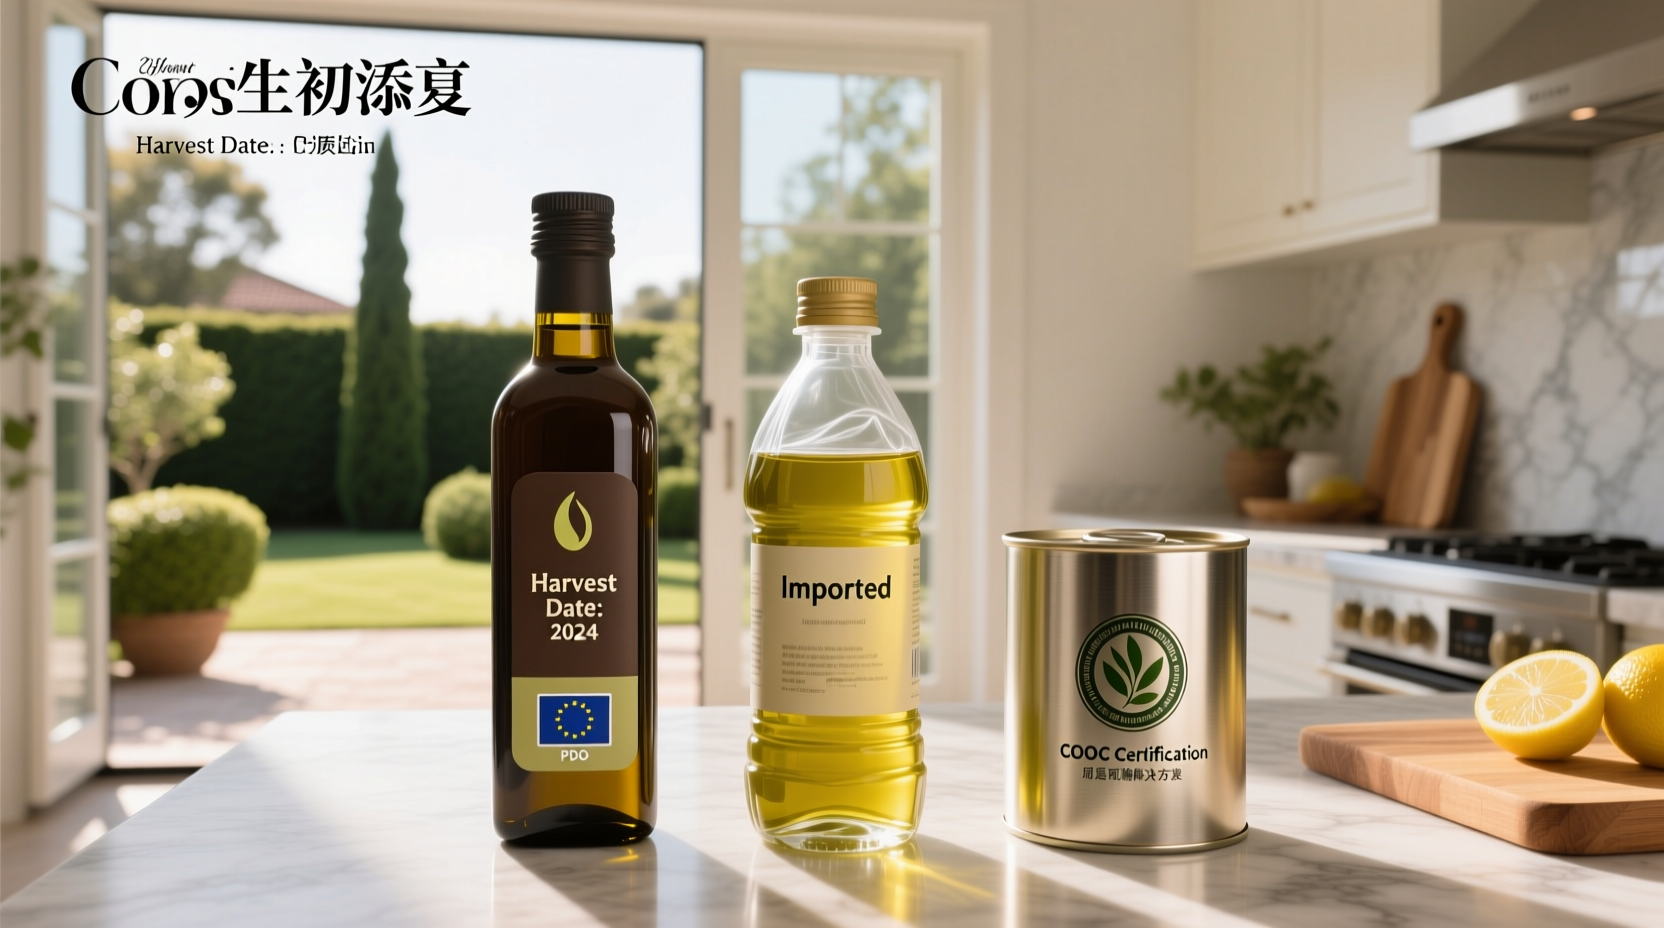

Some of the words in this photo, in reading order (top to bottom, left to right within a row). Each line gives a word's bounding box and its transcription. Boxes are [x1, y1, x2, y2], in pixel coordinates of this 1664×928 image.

[531, 572, 617, 593] Harvest
[782, 574, 891, 606] Imported
[546, 598, 603, 617] Date:
[550, 623, 599, 641] 2024
[560, 749, 590, 761] PDO
[1060, 743, 1110, 761] COOC
[1114, 744, 1208, 762] Certification
